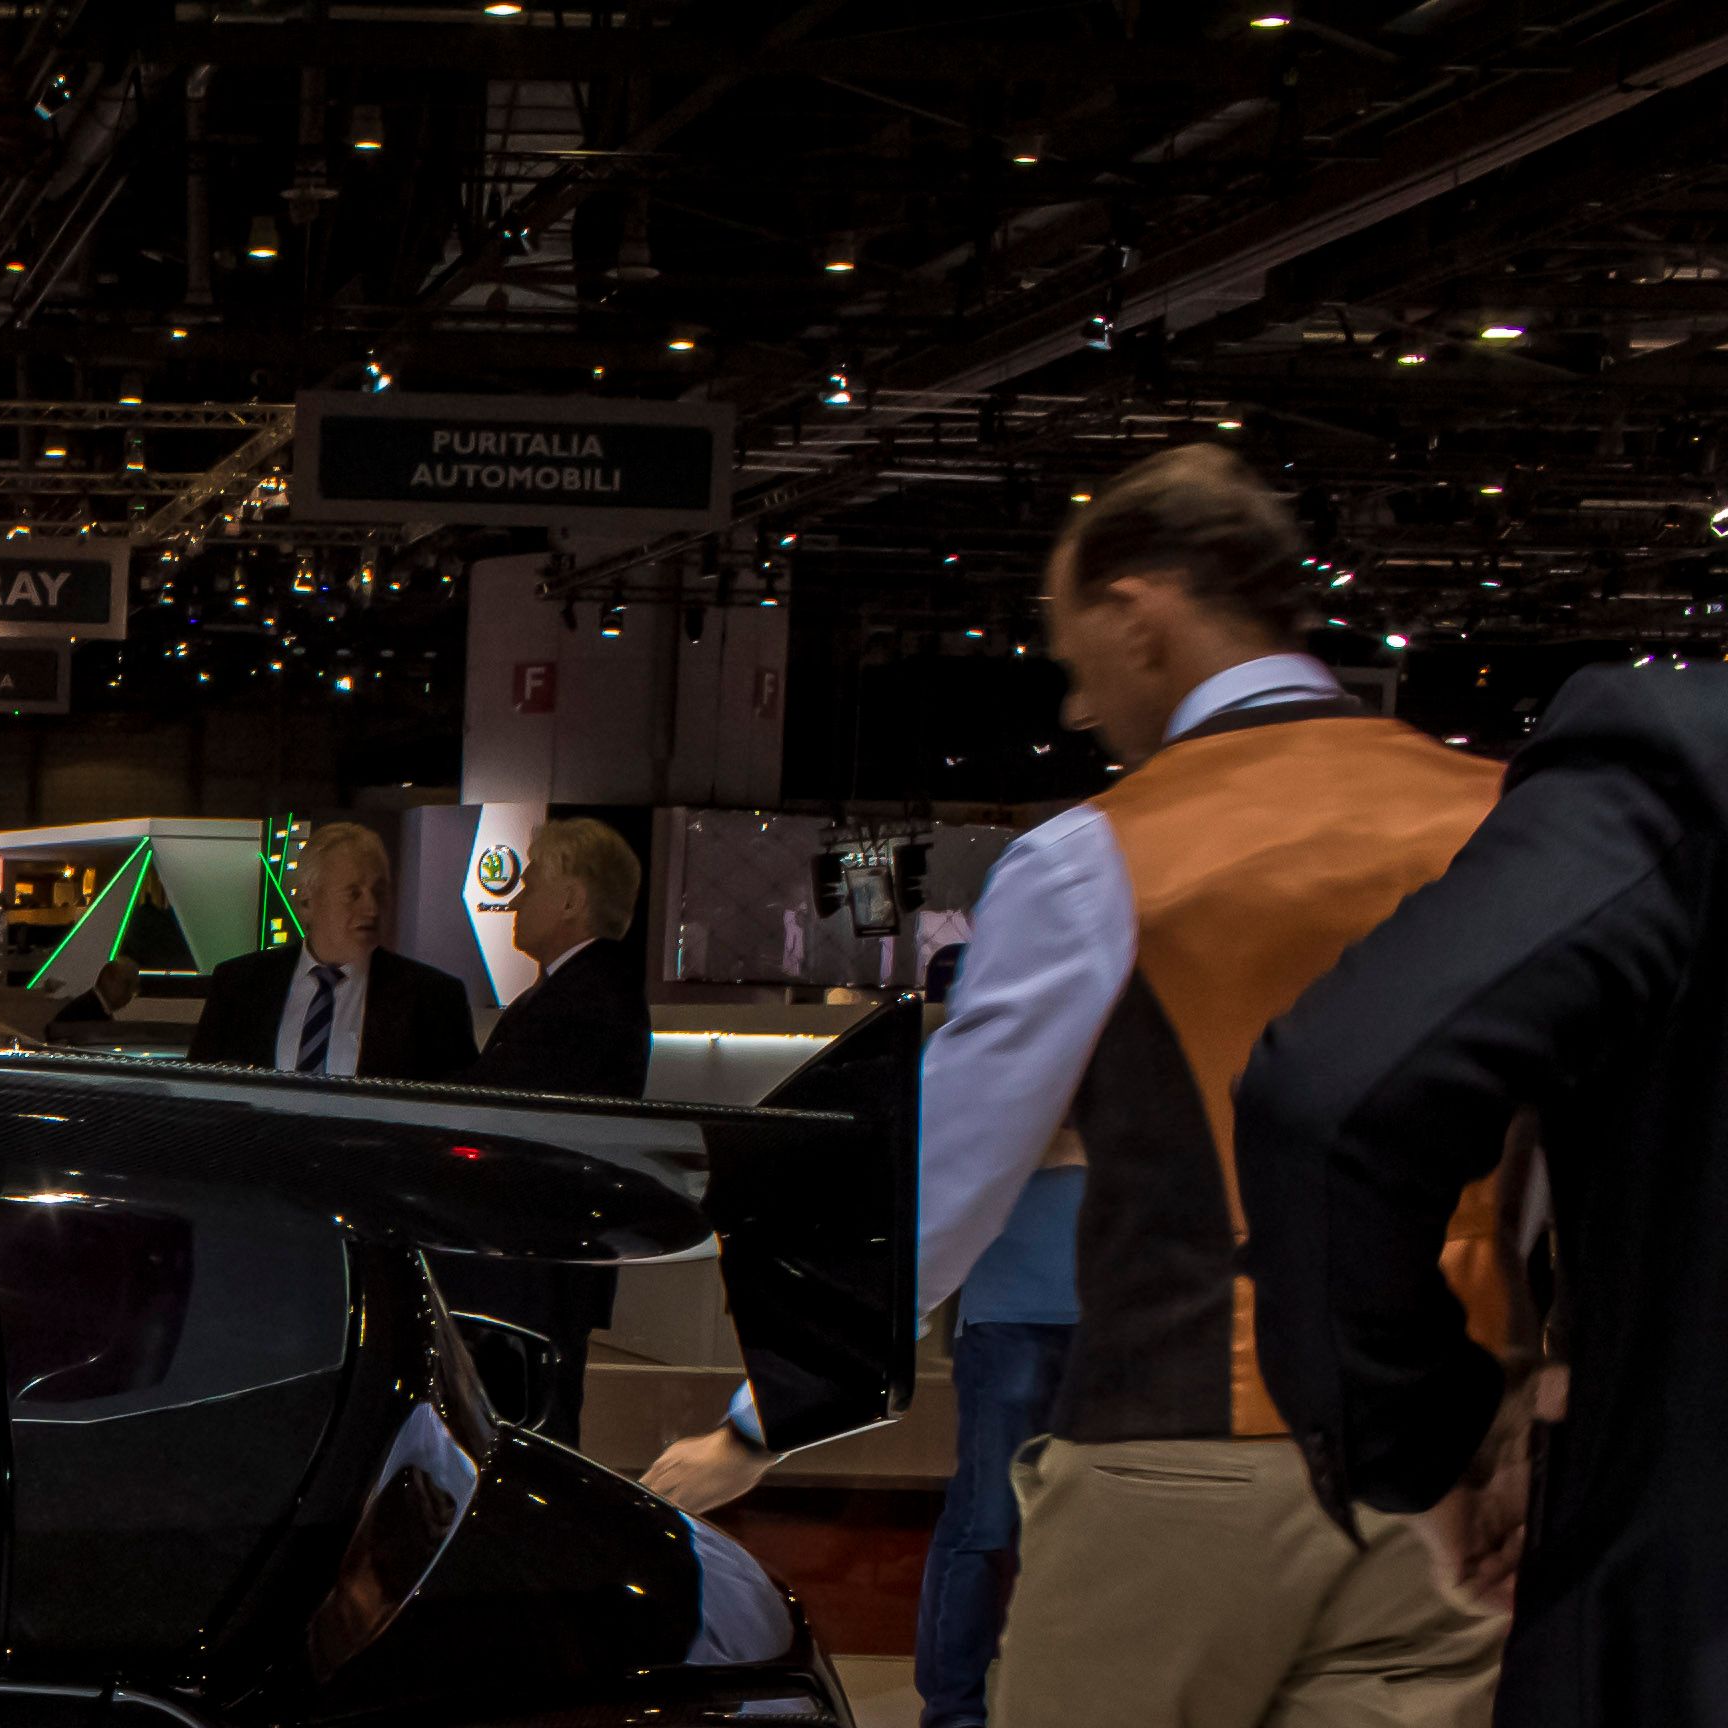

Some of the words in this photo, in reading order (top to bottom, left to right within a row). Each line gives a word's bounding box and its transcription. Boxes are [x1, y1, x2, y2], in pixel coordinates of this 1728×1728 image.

[432, 429, 604, 458] PURITALIA
[409, 463, 622, 493] AUTOMOBILI
[524, 666, 546, 701] F
